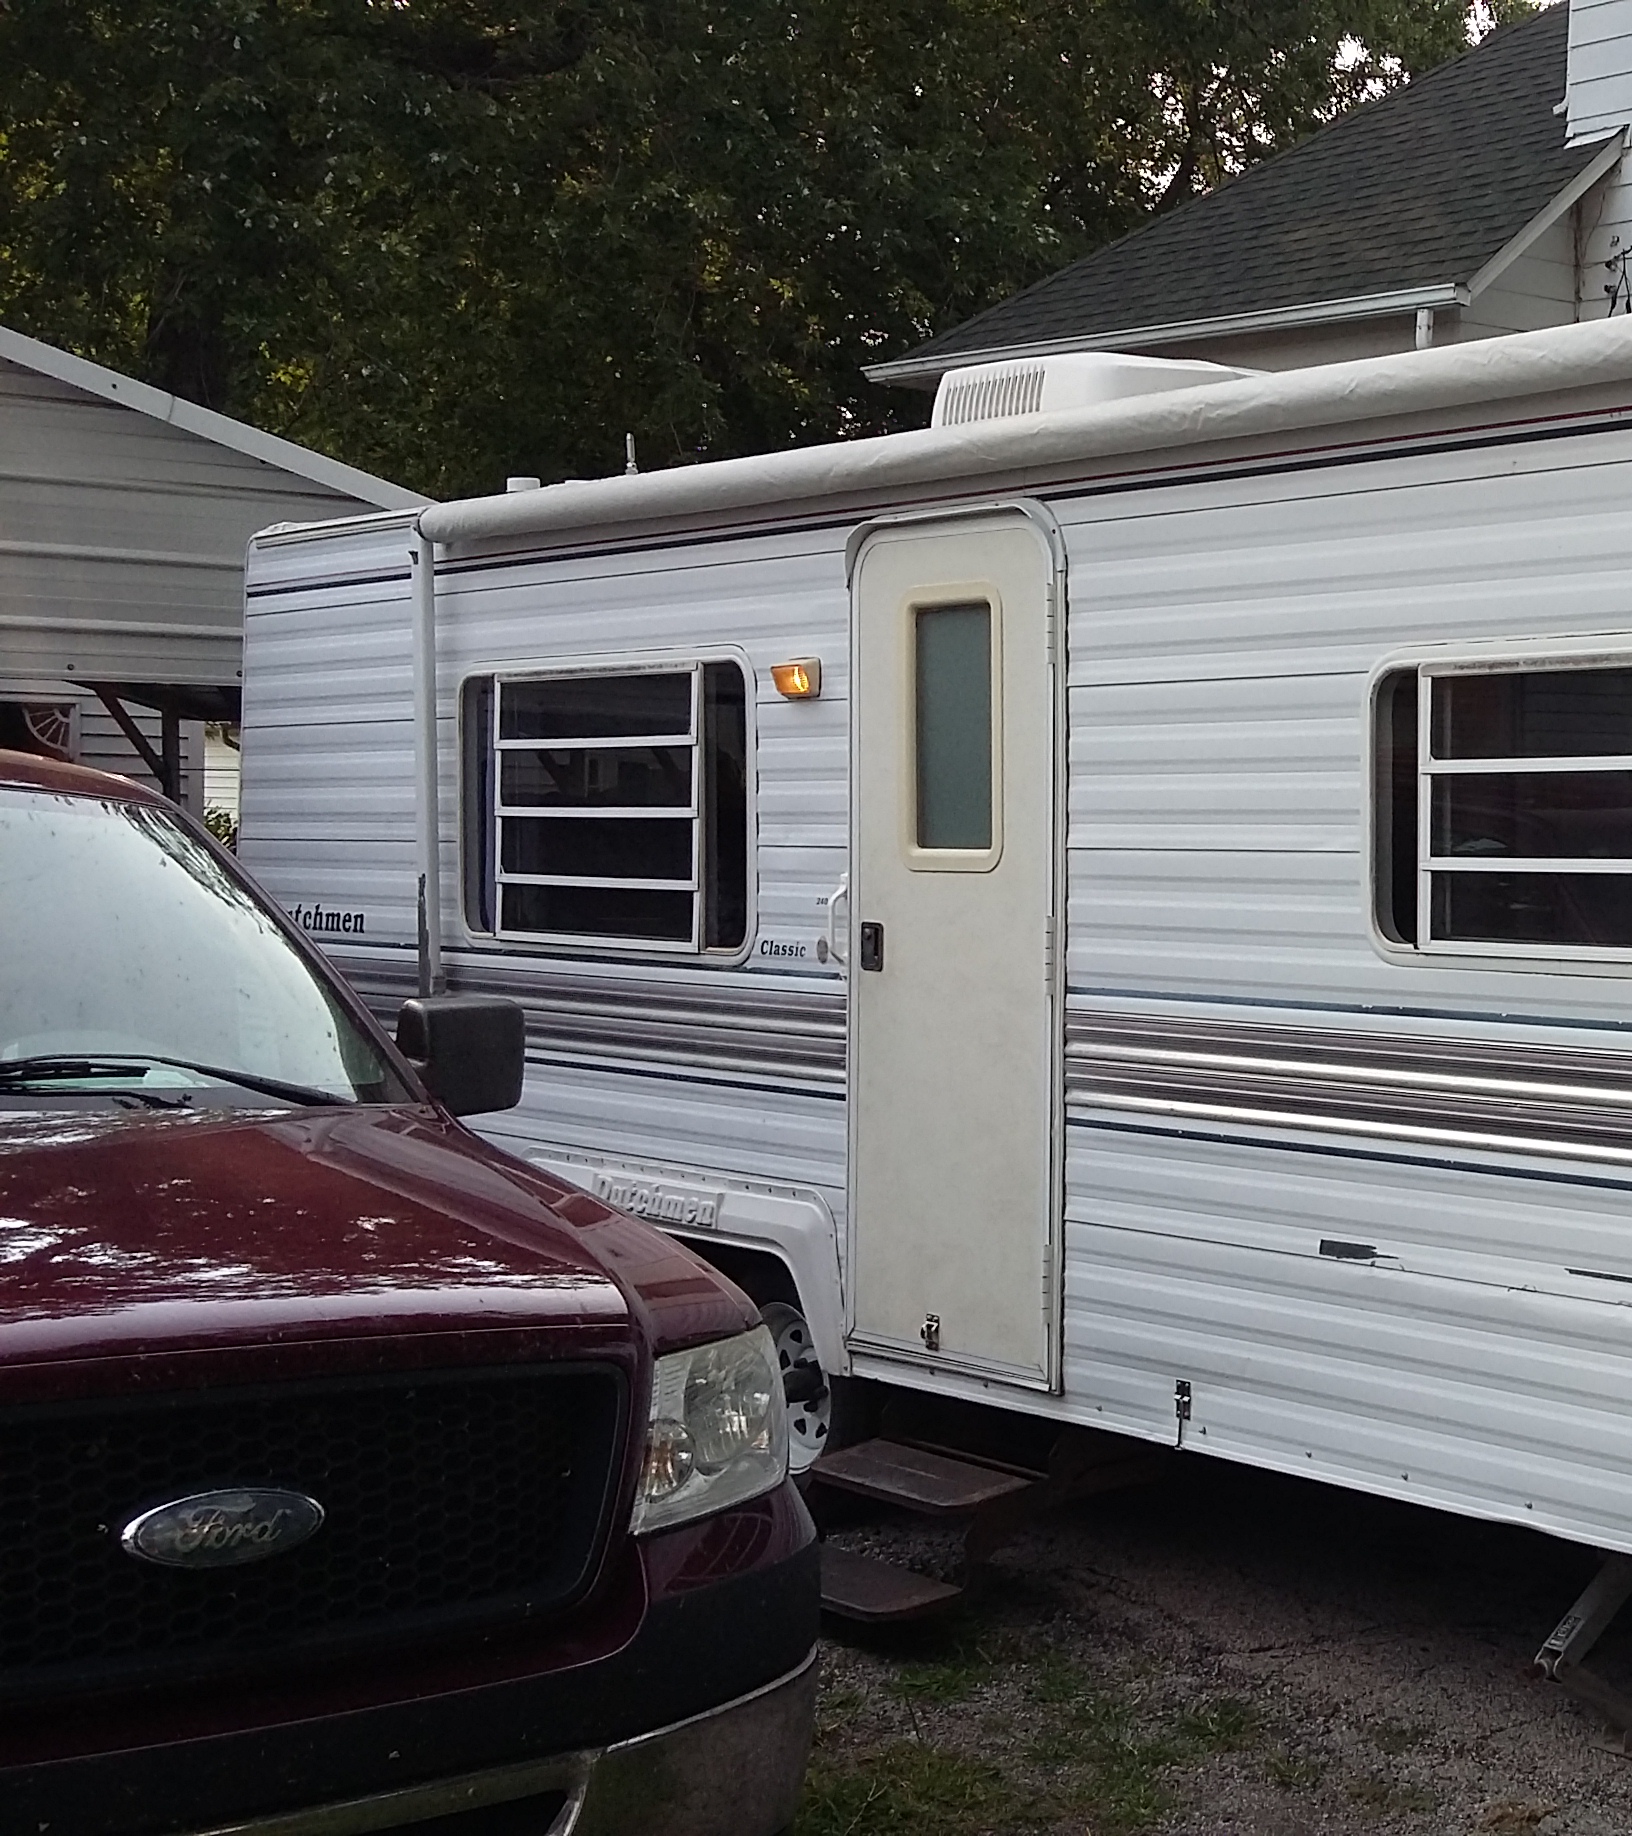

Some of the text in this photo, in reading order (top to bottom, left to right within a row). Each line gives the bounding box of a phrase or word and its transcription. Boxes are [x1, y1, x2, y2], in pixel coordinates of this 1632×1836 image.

[287, 903, 365, 933] tchmen
[760, 939, 807, 958] Classic
[174, 1496, 293, 1554] Ford
